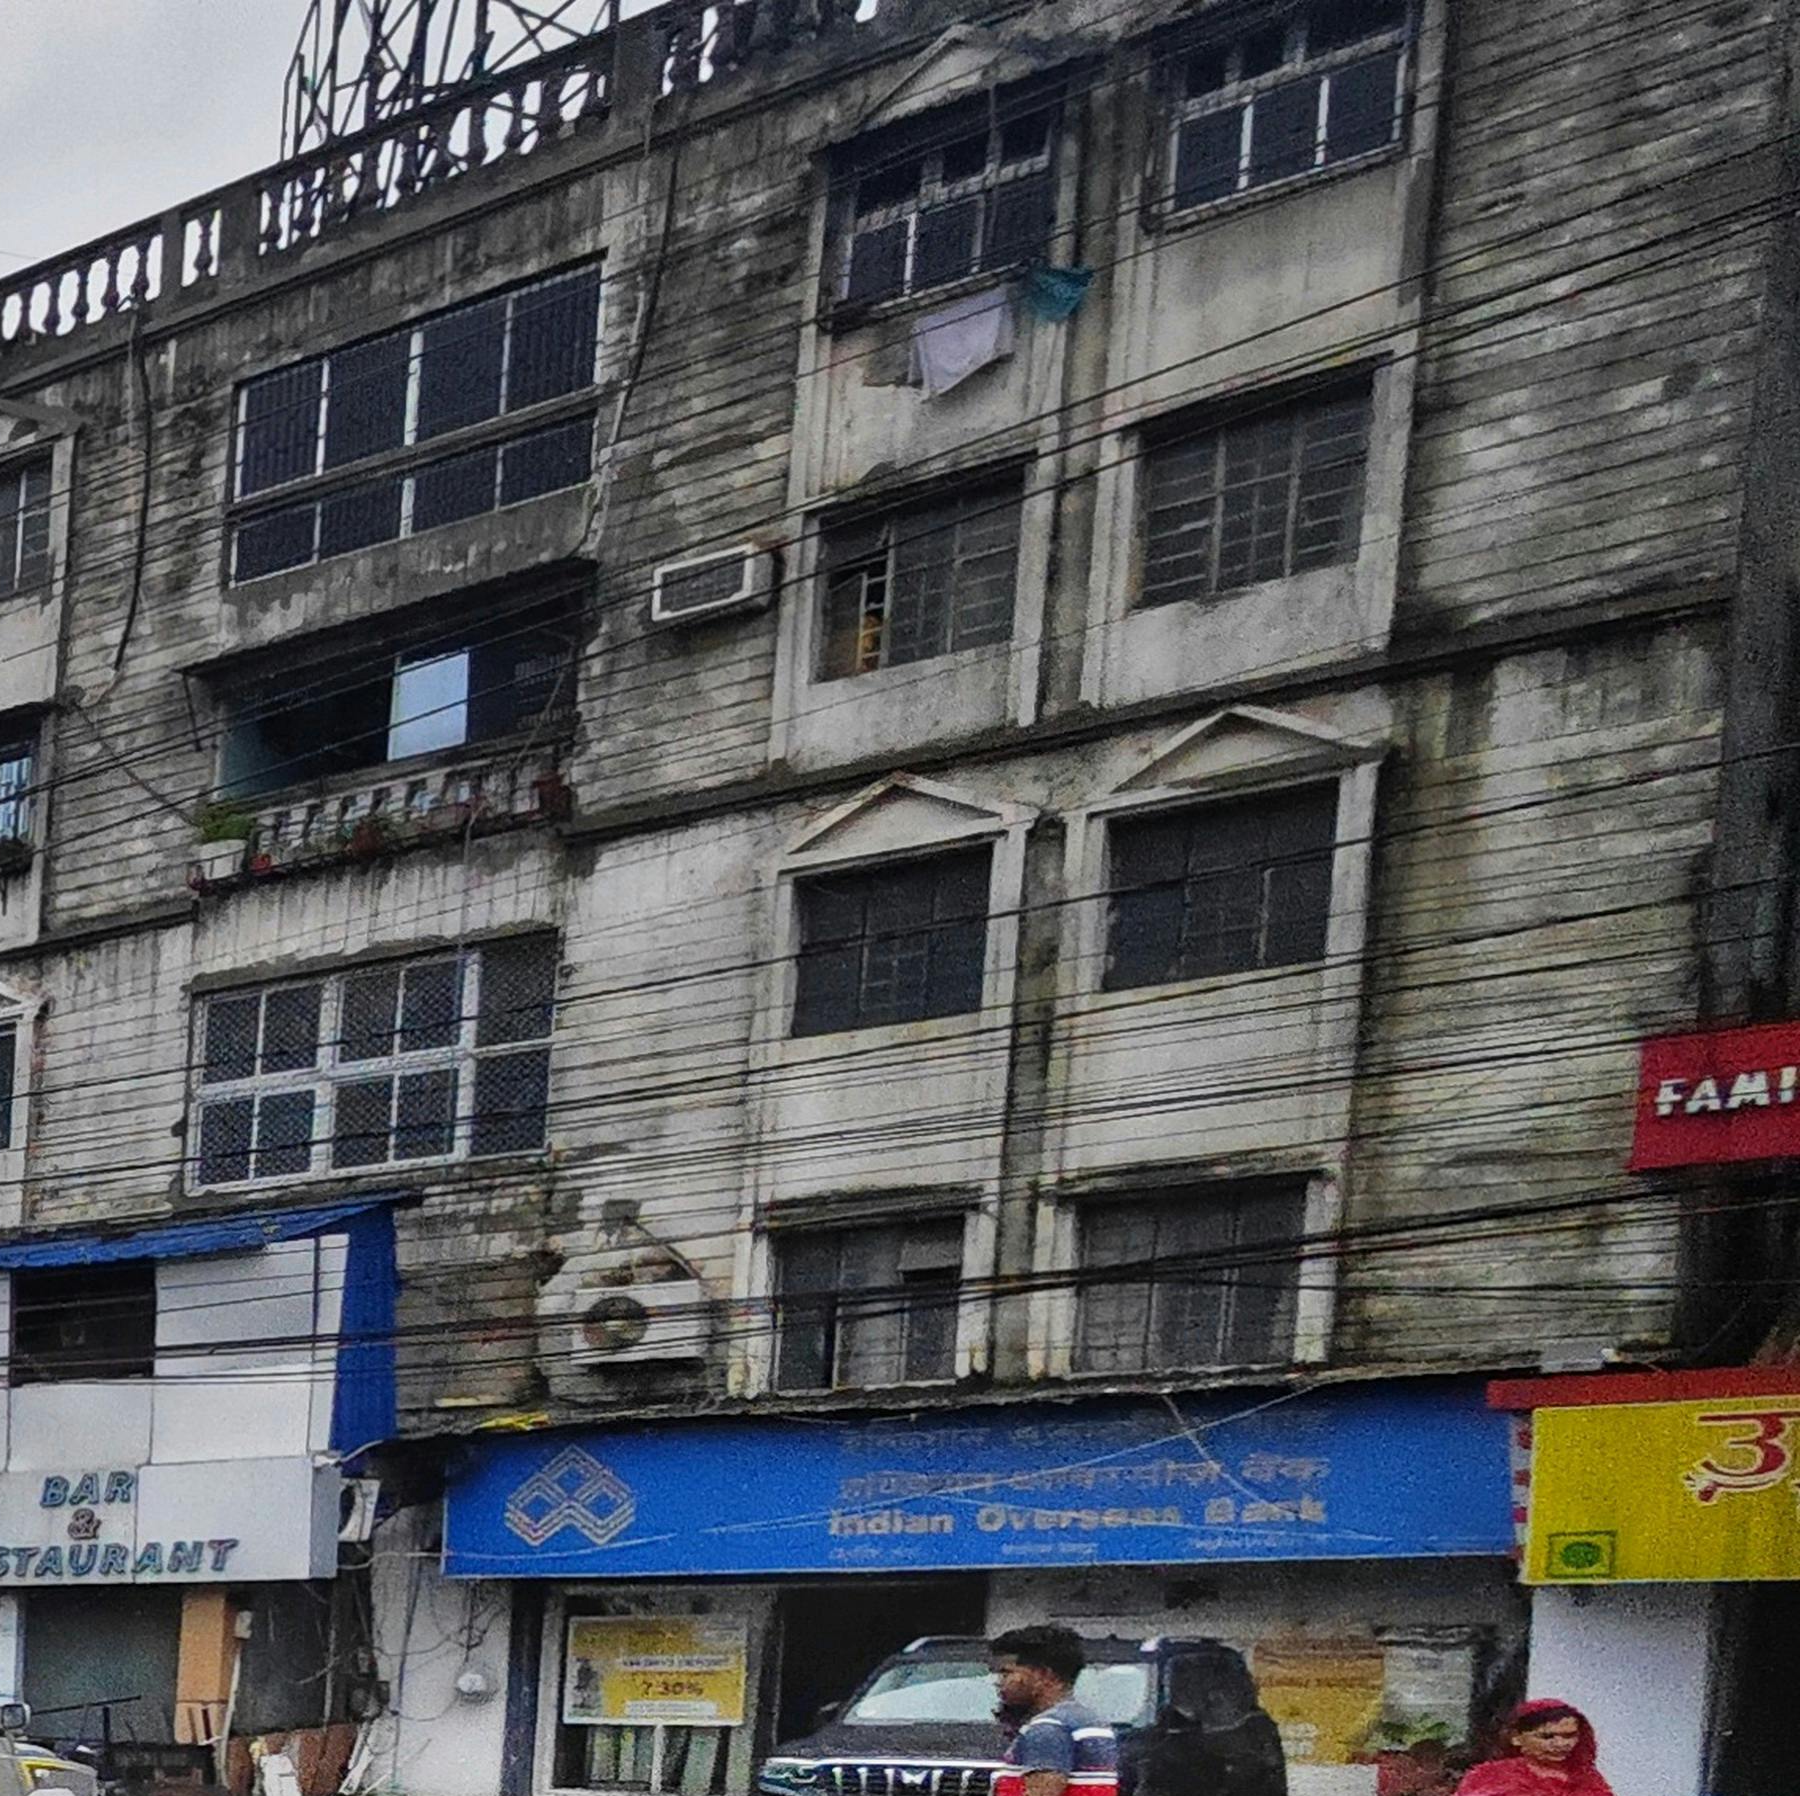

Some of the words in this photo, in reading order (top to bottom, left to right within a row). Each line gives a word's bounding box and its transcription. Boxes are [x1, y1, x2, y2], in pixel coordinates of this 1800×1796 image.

[40, 1471, 133, 1507] BAR
[67, 1508, 100, 1540] &
[1203, 1496, 1326, 1524] Bank
